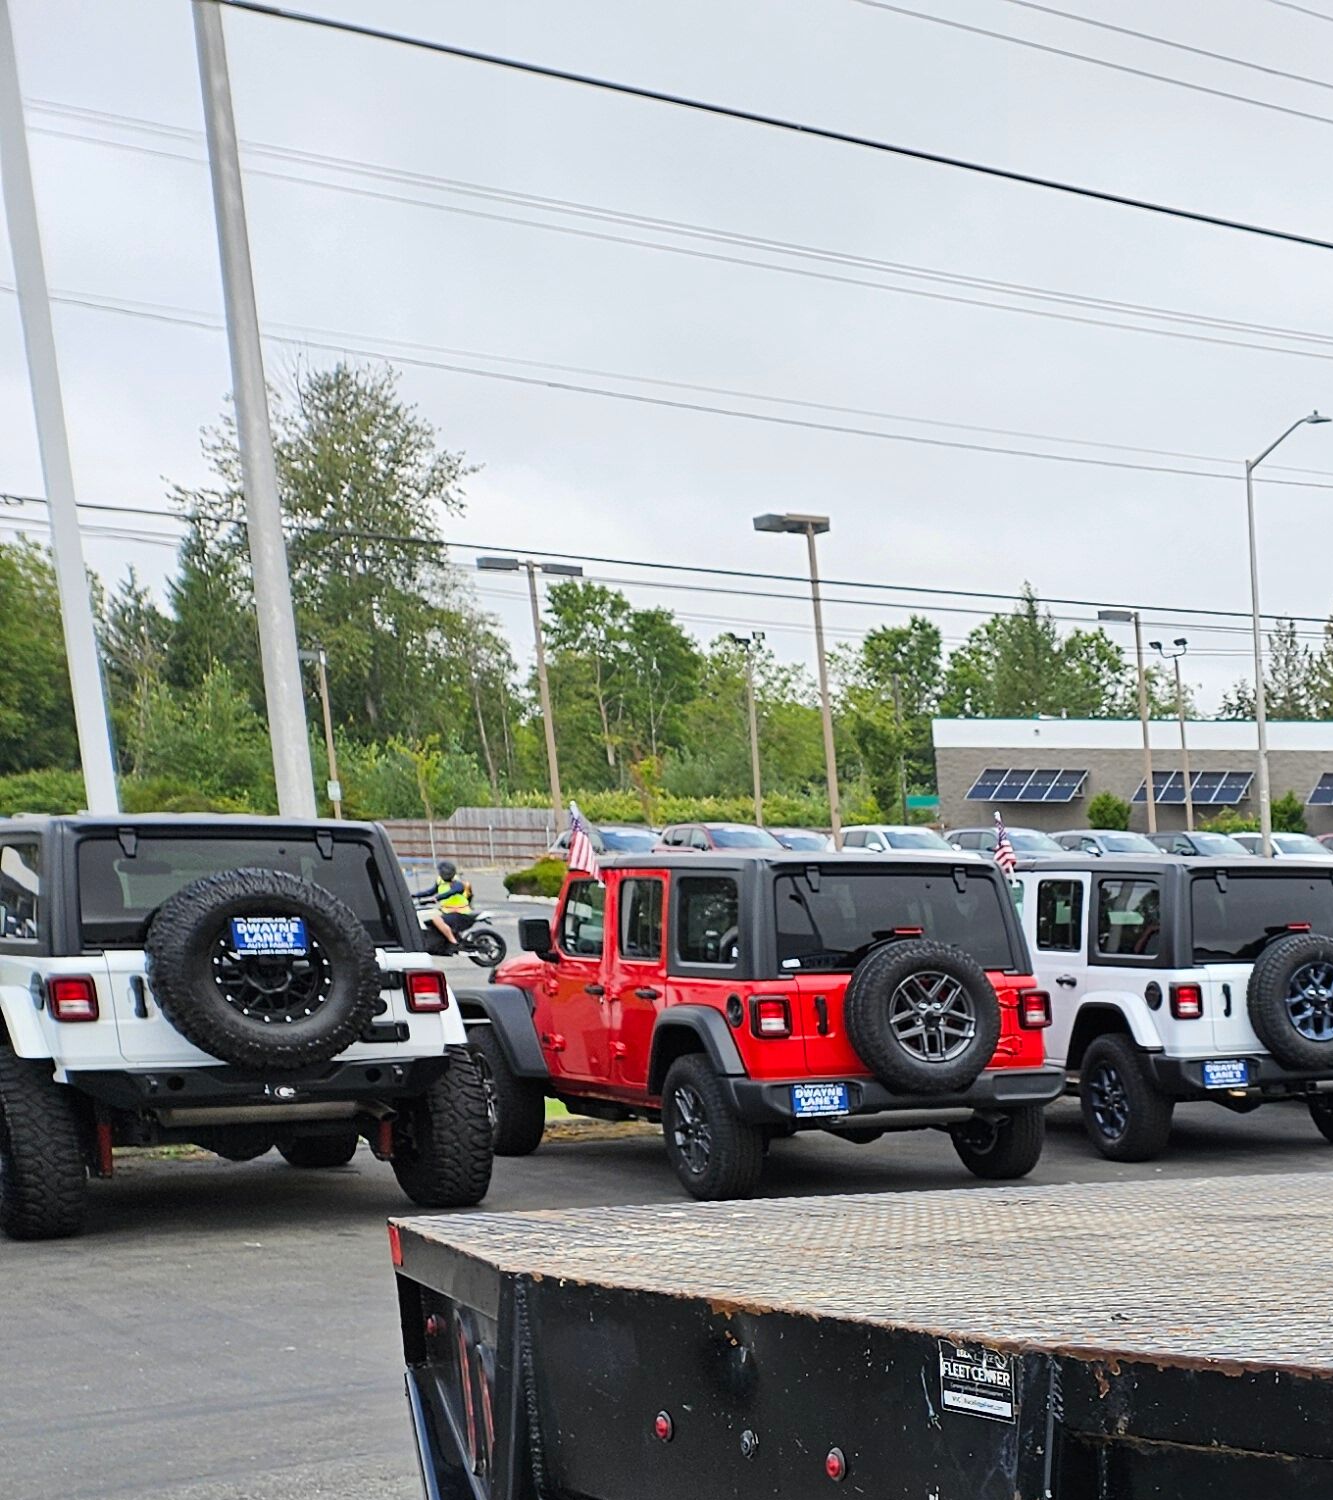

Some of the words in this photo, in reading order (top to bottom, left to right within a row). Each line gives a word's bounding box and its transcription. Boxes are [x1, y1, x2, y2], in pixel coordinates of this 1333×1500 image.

[236, 922, 299, 934] DWAYNE
[244, 931, 294, 943] LANE'S
[1205, 1062, 1244, 1073] DWAYNE
[795, 1087, 843, 1098] DWAYNE
[801, 1095, 840, 1106] LANE'S
[943, 1361, 971, 1379] FLEET
[971, 1366, 1011, 1387] CENTER
